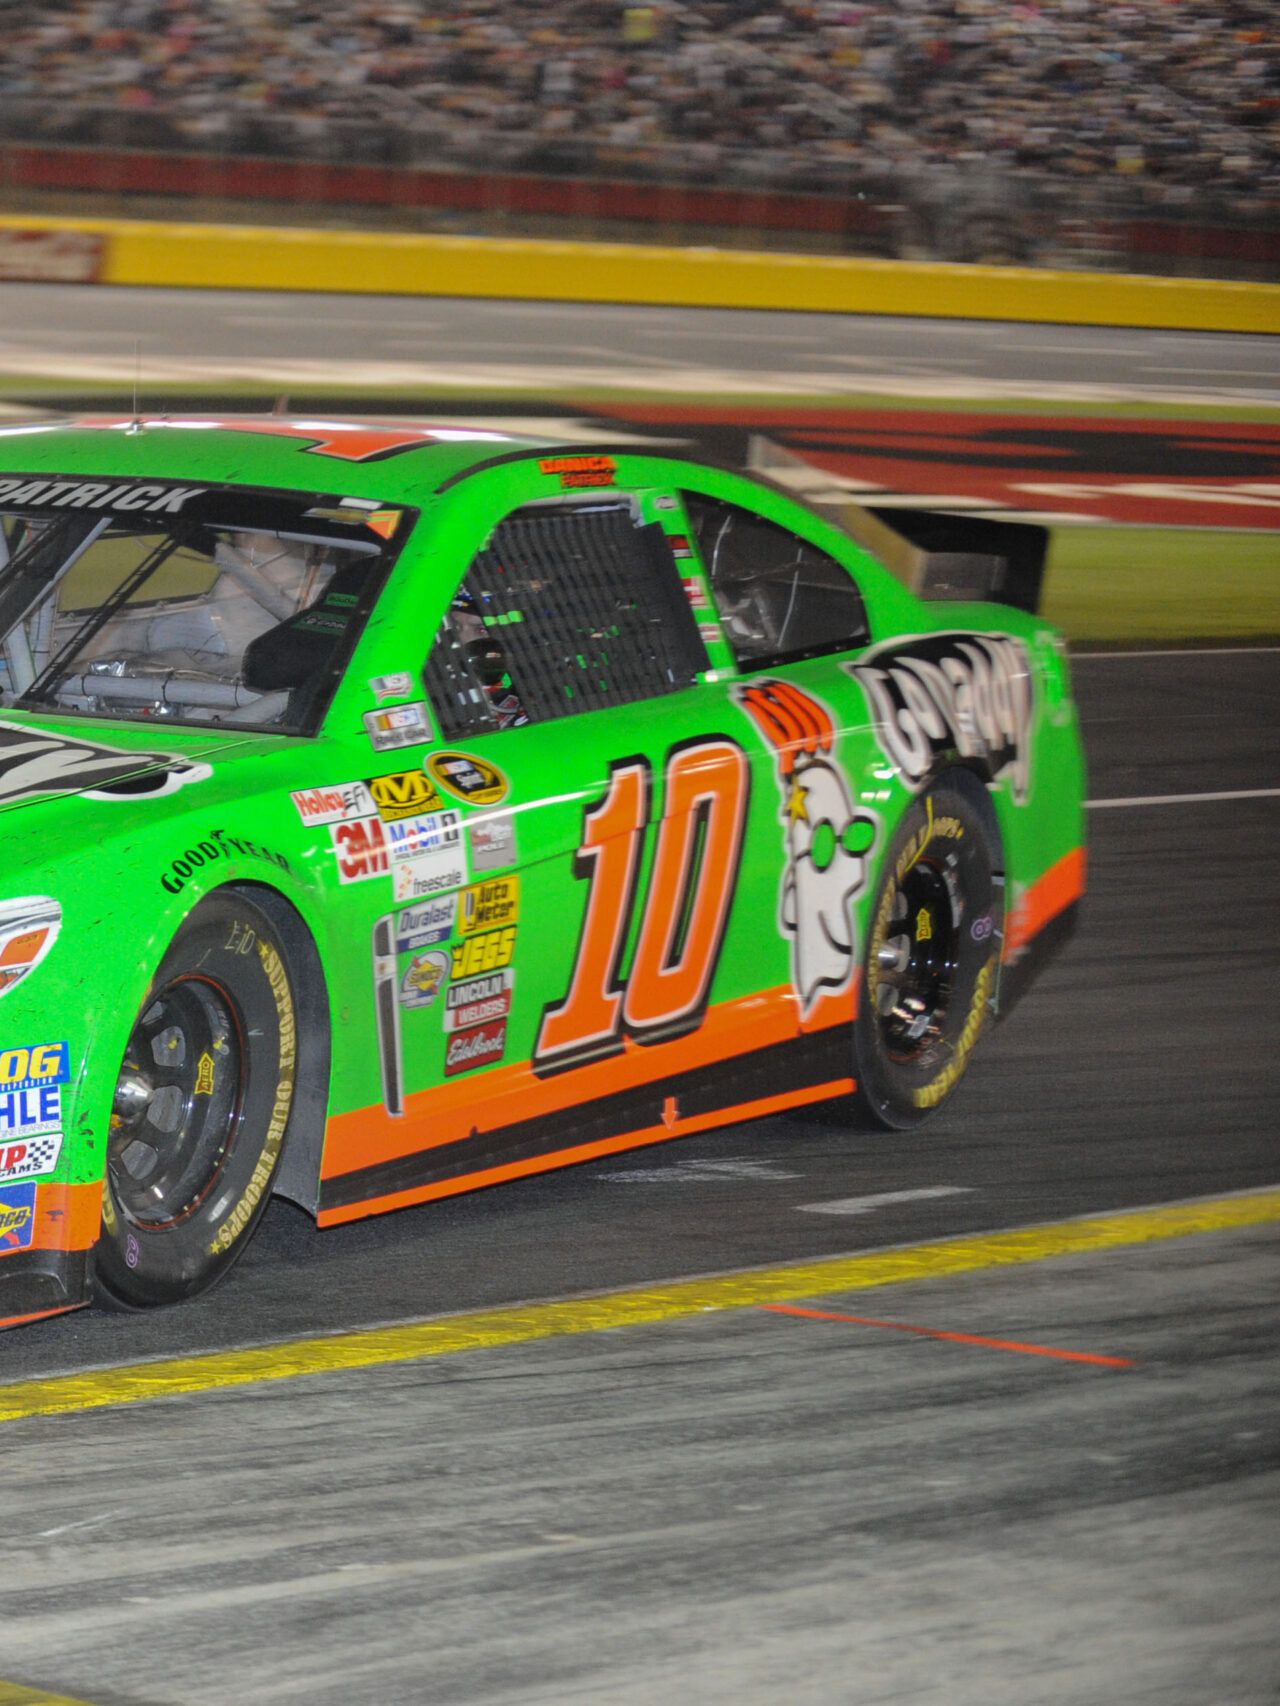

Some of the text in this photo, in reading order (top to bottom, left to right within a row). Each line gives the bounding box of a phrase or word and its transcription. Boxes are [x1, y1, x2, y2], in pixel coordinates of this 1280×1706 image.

[293, 789, 345, 817] Holley
[335, 818, 389, 878] 3M
[389, 816, 440, 855] Mobil
[412, 868, 462, 896] freescale
[479, 884, 509, 903] Auto
[532, 718, 750, 1075] 10
[400, 898, 454, 933] Duralast
[475, 901, 516, 922] Meter
[451, 927, 517, 980] JEGS
[447, 975, 503, 1009] LINCOLN
[457, 997, 507, 1024] WELDERS
[446, 1027, 505, 1066] Edelbrock
[266, 1080, 293, 1141] OUR
[218, 1149, 276, 1250] TROOPS
